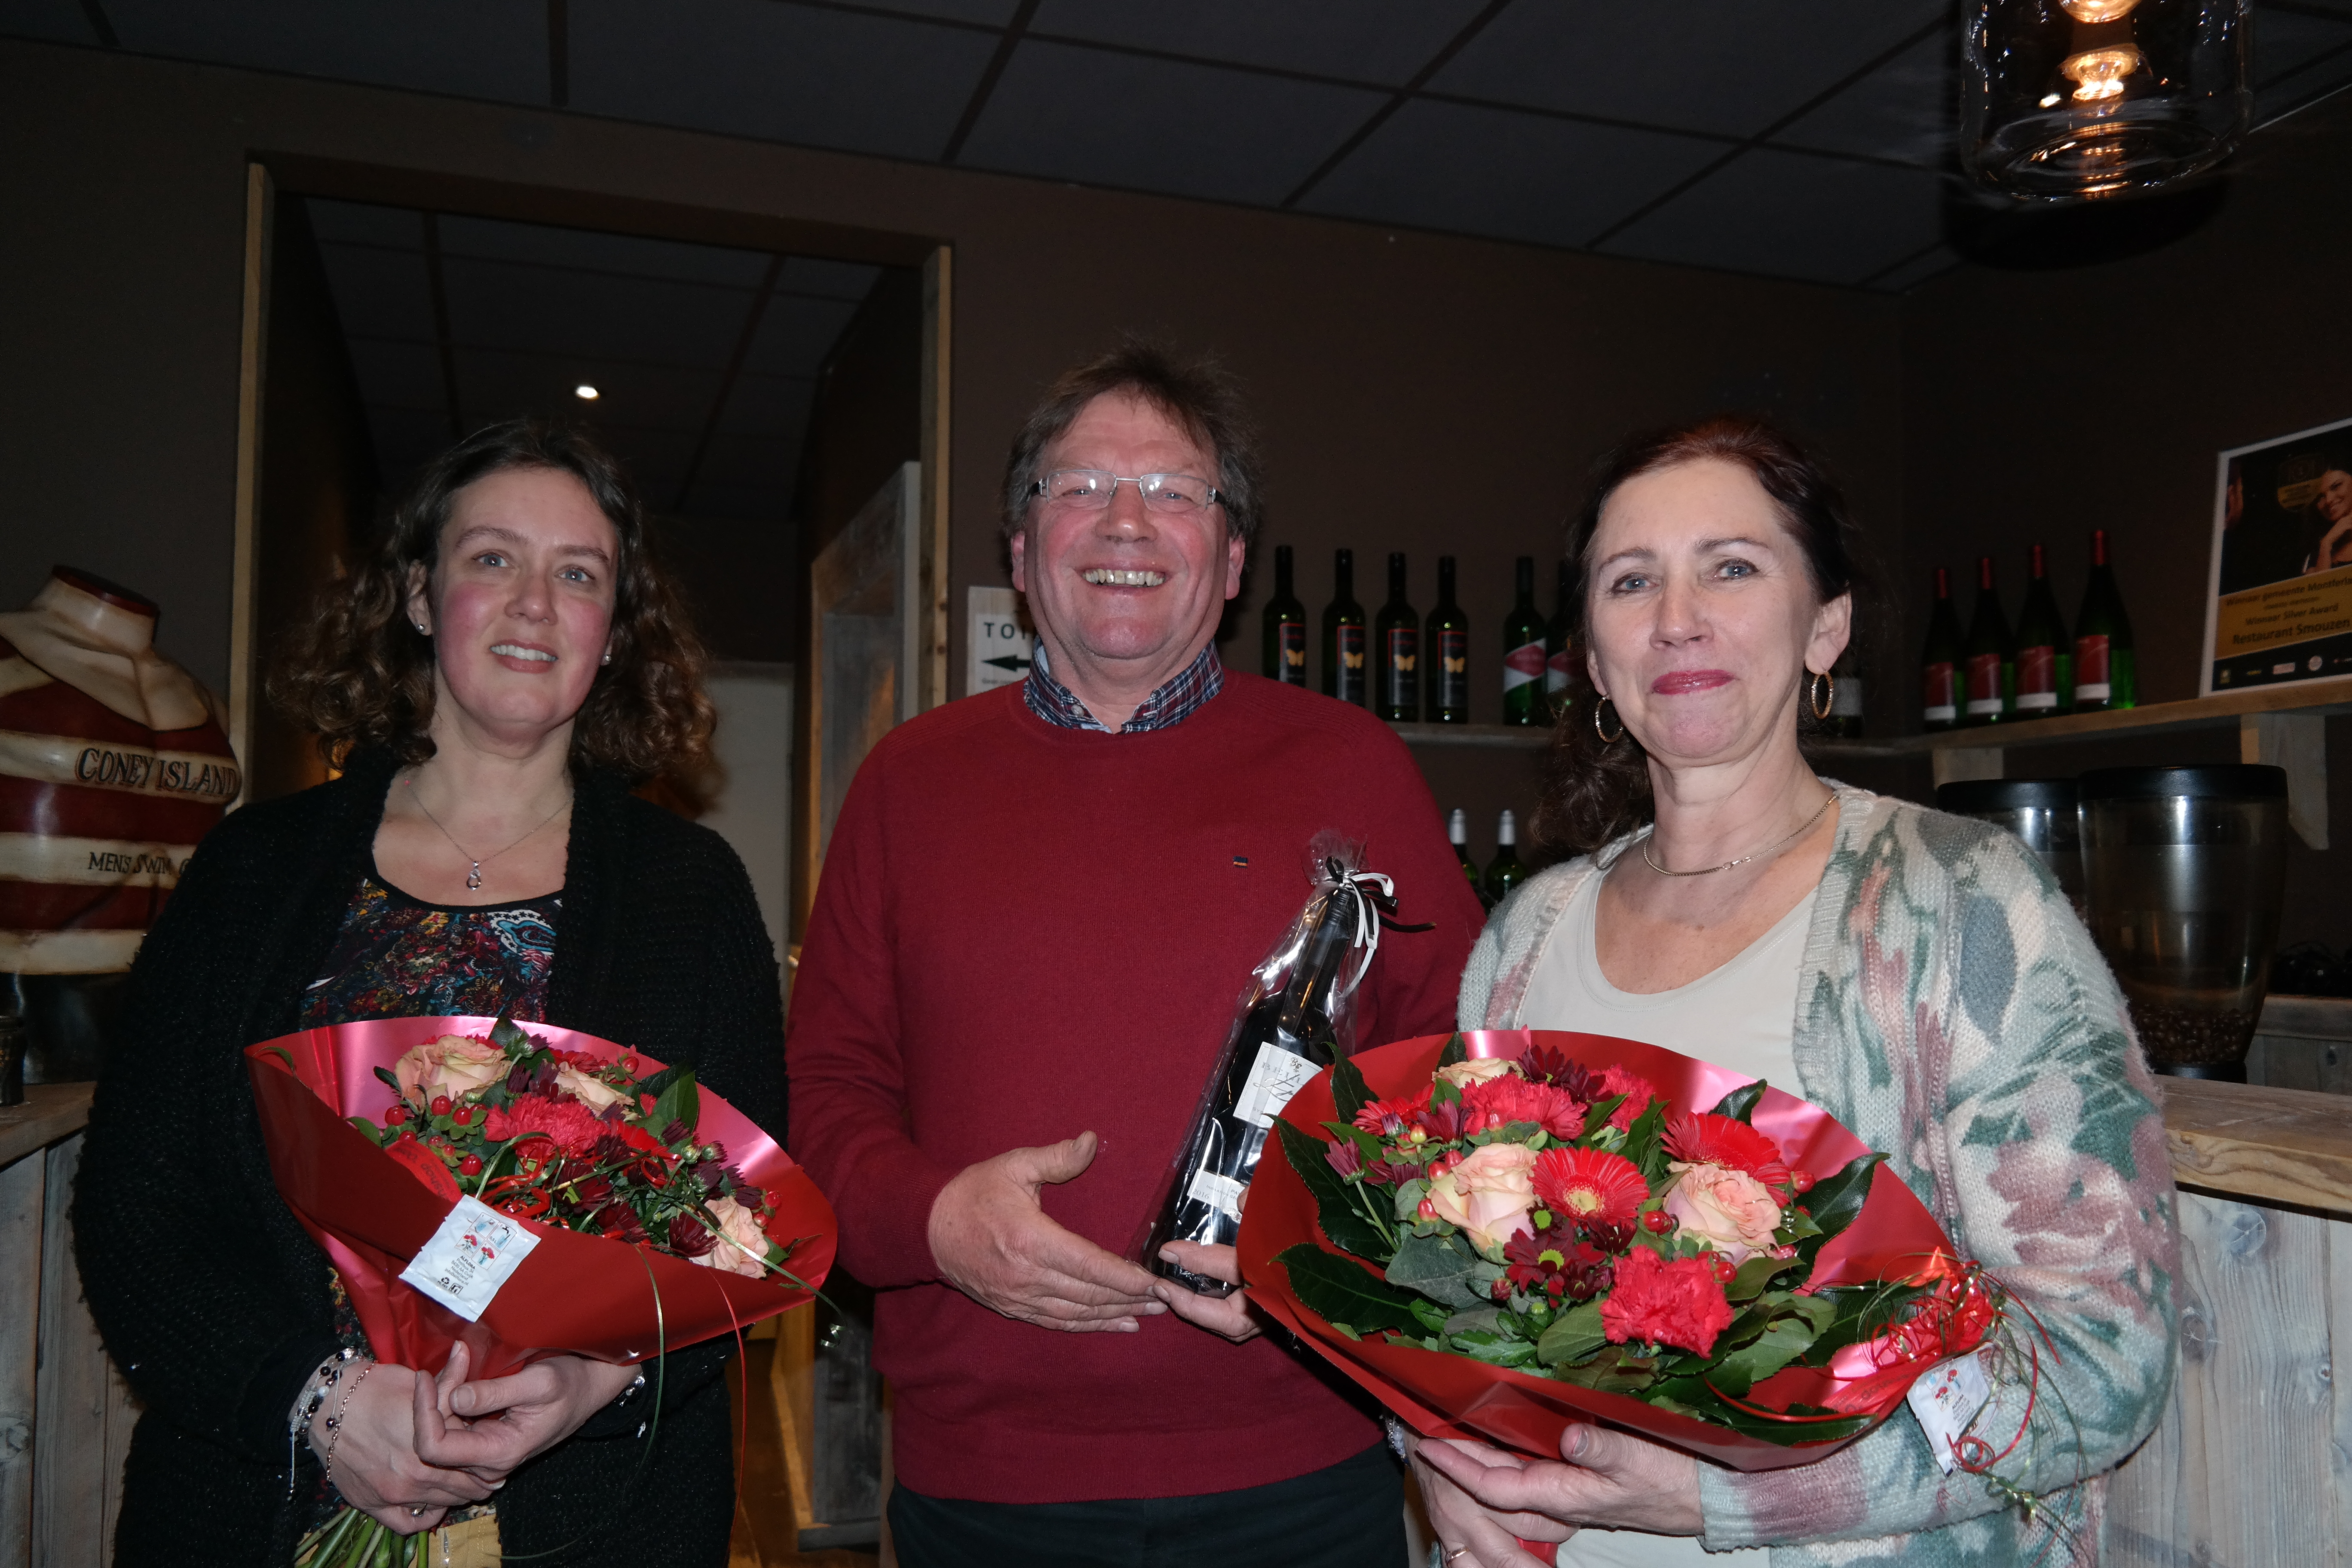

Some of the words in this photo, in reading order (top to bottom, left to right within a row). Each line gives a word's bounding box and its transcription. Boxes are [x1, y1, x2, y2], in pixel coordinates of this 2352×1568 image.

[2283, 609, 2307, 620] Silver
[2309, 604, 2339, 615] Award
[2233, 626, 2293, 644] Restaurant
[2296, 619, 2350, 636] Smouzen
[76, 747, 154, 788] CONEY
[155, 759, 237, 796] ISLAND
[132, 852, 172, 875] SWIM
[1192, 1188, 1210, 1199] 2016
[456, 1258, 469, 1271] Postbus
[460, 1255, 475, 1269] ALFLORA
[450, 1266, 469, 1280] Nederland
